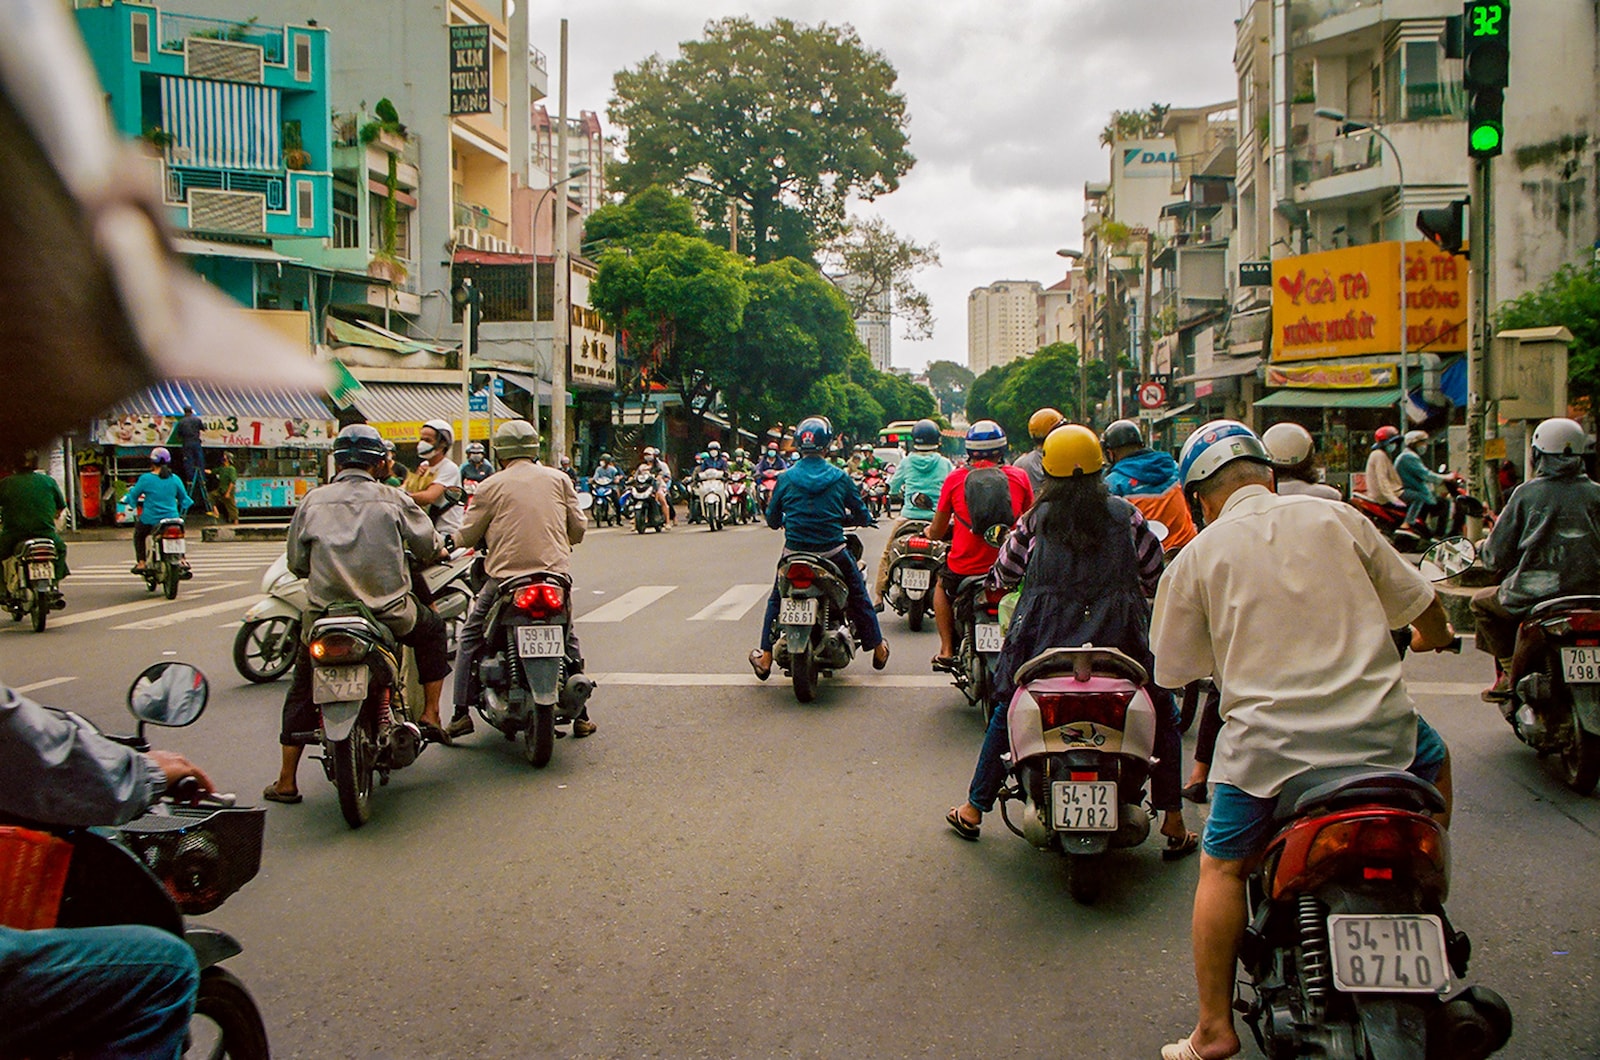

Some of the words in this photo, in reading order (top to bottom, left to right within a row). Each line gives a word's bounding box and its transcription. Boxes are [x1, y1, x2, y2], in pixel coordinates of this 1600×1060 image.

[1473, 5, 1501, 36] 32
[456, 48, 483, 67] KIM
[453, 94, 487, 112] LONG
[1430, 255, 1458, 281] TA
[1305, 268, 1336, 304] GÀ
[1339, 271, 1369, 300] TA
[226, 416, 239, 432] 3
[250, 421, 262, 445] 1
[1061, 785, 1107, 805] 54-T2
[1061, 807, 1108, 827] 4782
[1345, 921, 1422, 950] 54-H1
[1350, 955, 1431, 985] 8740
